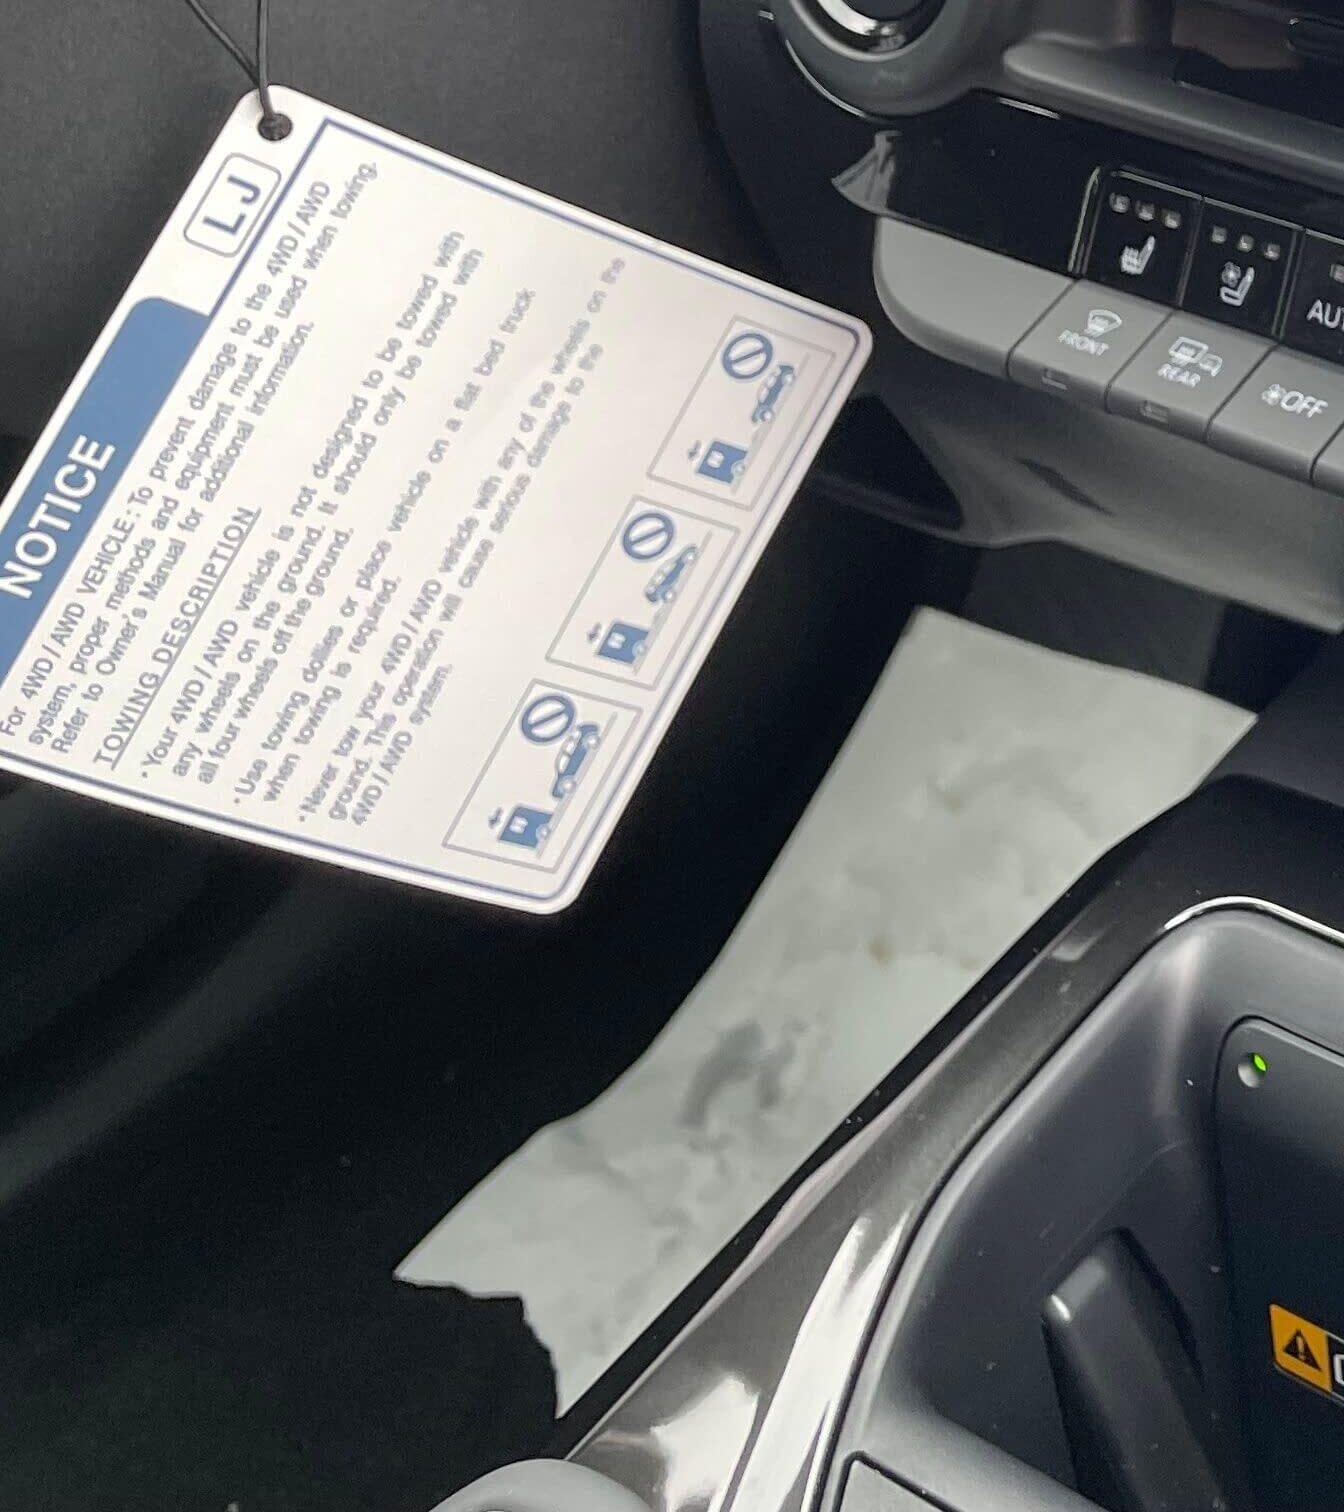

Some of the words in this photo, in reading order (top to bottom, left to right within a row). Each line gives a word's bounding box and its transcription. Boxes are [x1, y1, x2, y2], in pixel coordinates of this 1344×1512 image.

[1056, 329, 1109, 356] FRONT
[1280, 390, 1328, 418] OFF
[0, 434, 116, 600] NOTICE
[91, 671, 162, 764] TOWING
[150, 506, 255, 666] DESCRIPTION
